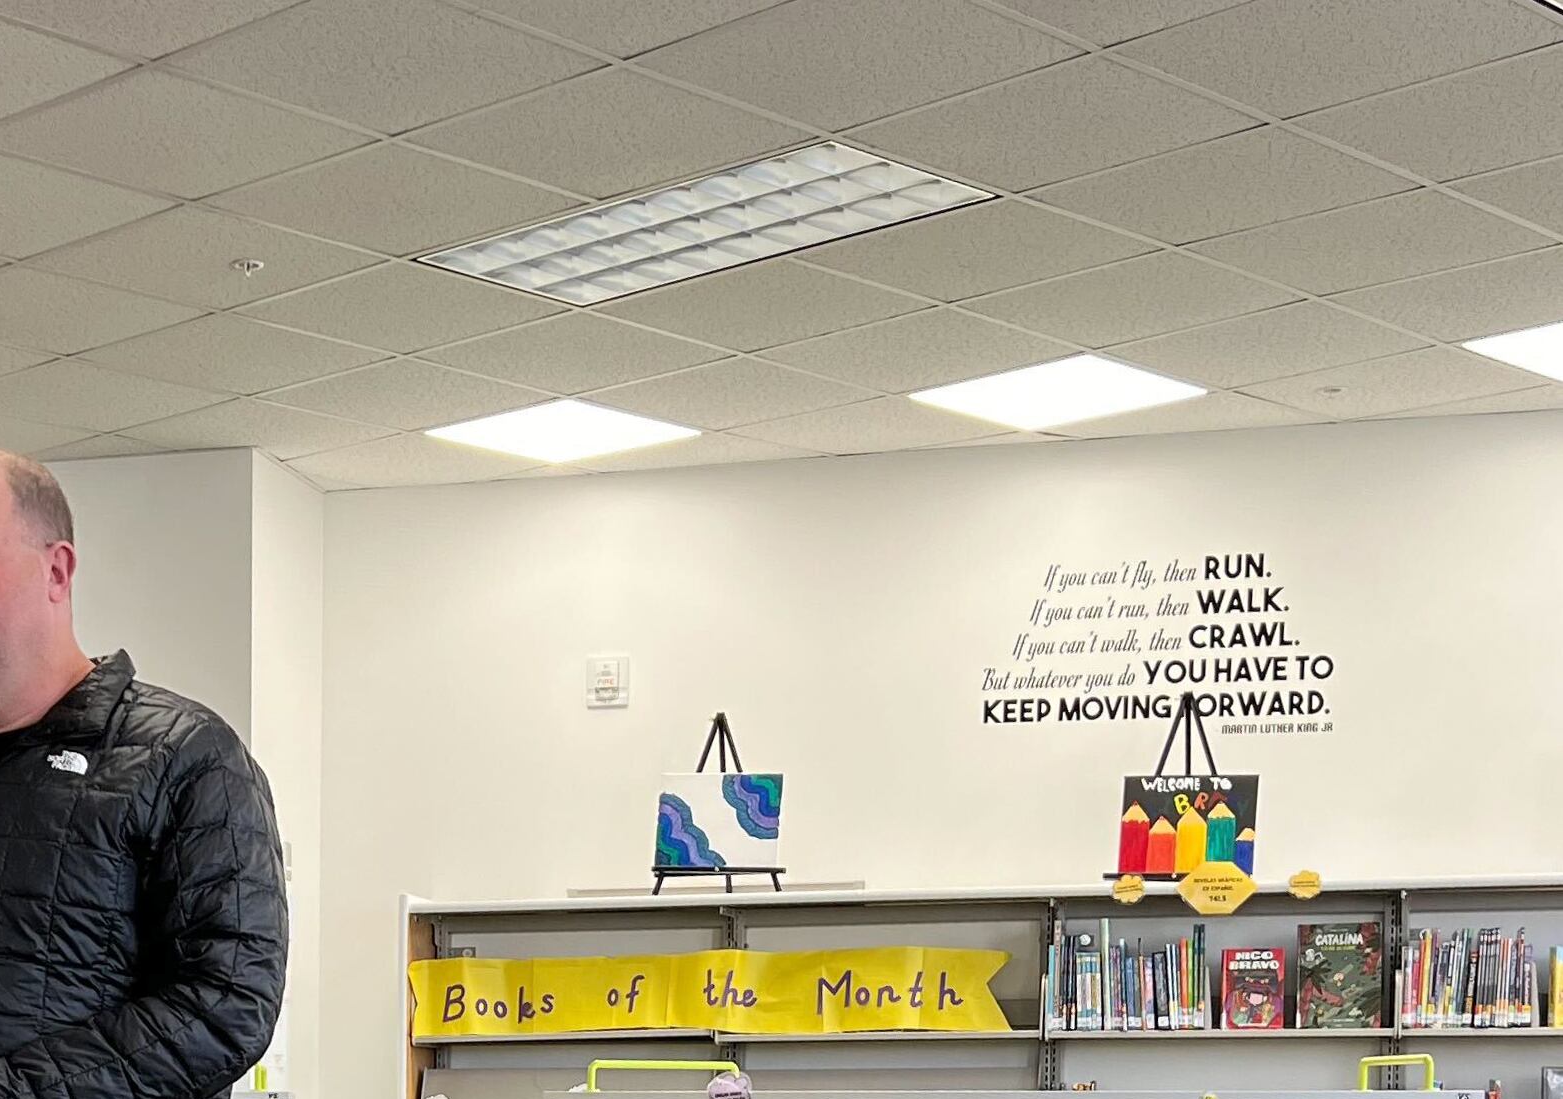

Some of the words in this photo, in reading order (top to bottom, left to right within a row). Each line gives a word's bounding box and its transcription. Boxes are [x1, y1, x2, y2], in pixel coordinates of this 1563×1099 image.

[1043, 564, 1058, 592] If
[1058, 573, 1087, 593] you
[1091, 561, 1131, 587] can't
[1131, 560, 1157, 591] fly,
[1164, 559, 1197, 583] then
[1204, 553, 1273, 581] RUN.
[1029, 599, 1044, 626] If
[1042, 606, 1073, 628] you
[1076, 596, 1116, 621] can't
[1117, 605, 1150, 622] run,
[1156, 594, 1190, 618] then
[1196, 587, 1290, 616] WALK.
[1012, 633, 1028, 661] If
[1027, 642, 1056, 662] you
[1059, 631, 1098, 655] can't
[1099, 629, 1142, 655] walk,
[1149, 628, 1182, 652] then
[1188, 622, 1301, 650] CRAWL.
[981, 667, 1010, 692] But
[1013, 666, 1083, 690] whatever
[1084, 674, 1114, 694] you
[1117, 663, 1136, 688] do
[1142, 659, 1207, 686] YOU
[1214, 656, 1289, 684] HAVE
[1295, 655, 1334, 681] TO
[983, 698, 1051, 724] KEEP
[1058, 694, 1172, 722] MOVING
[1221, 723, 1258, 735] MARTIN
[1260, 722, 1295, 734] LUTHER
[1297, 722, 1319, 734] KING
[1321, 722, 1334, 733] JR
[1141, 777, 1201, 793] WELCOME
[1209, 777, 1233, 791] TO
[1229, 960, 1280, 970] BRAVO
[1235, 951, 1274, 961] NICO
[442, 984, 555, 1024] Books
[607, 975, 646, 1013] of
[703, 968, 758, 1009] the
[816, 970, 964, 1015] Month
